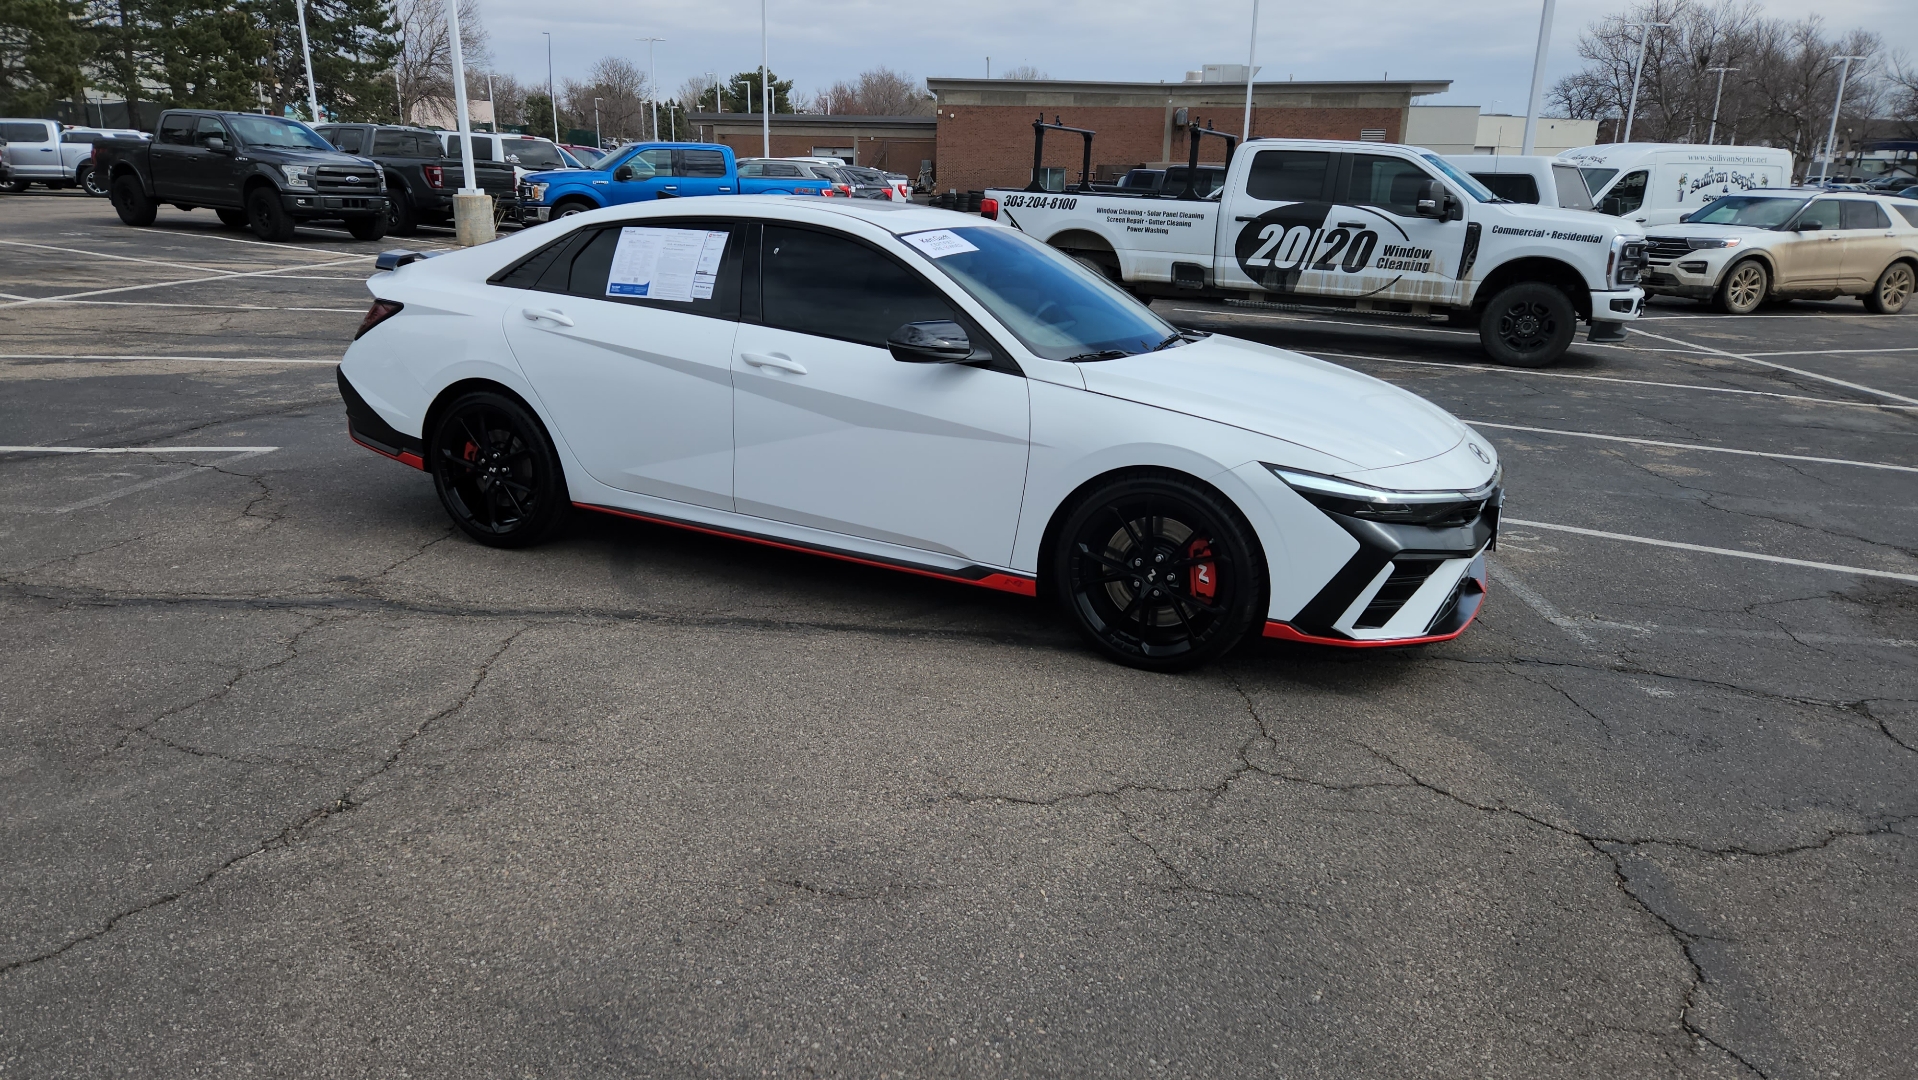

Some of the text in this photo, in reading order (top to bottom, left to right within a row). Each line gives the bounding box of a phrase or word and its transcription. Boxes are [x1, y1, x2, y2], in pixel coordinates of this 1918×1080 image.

[1688, 155, 1767, 164] www.SullivanSeptic.net
[1690, 167, 1728, 194] Sullivan
[1722, 184, 1729, 193] &
[1003, 195, 1077, 210] 303-204-8100
[1118, 208, 1143, 216] Cleaning
[1179, 212, 1204, 220] Cleaning
[1126, 217, 1144, 225] Repair
[1149, 218, 1166, 226] Gutter
[1166, 219, 1192, 227] Cleaning
[1144, 226, 1169, 235] Washing
[1492, 225, 1604, 244] Commercial Residential
[1382, 244, 1433, 260] Window
[1376, 257, 1431, 273] Cleaning
